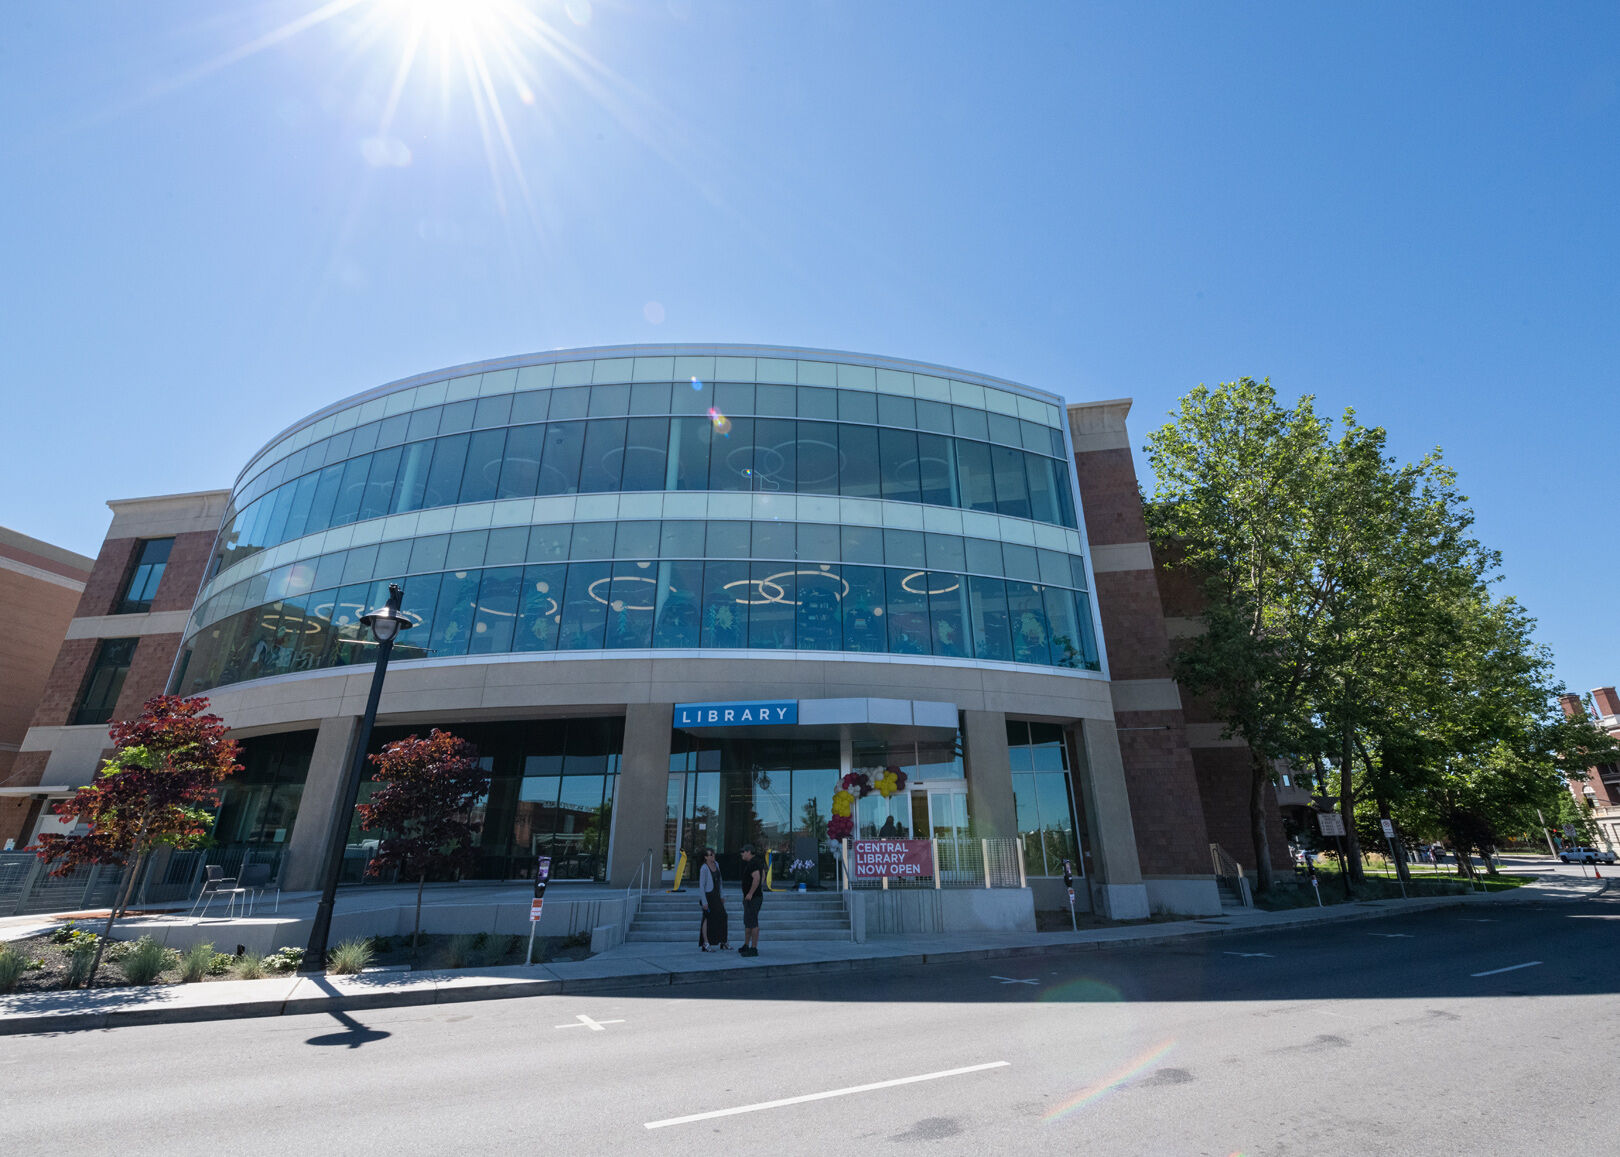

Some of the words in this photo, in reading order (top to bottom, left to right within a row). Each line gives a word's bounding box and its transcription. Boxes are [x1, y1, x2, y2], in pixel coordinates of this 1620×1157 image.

[683, 708, 787, 723] LIBRARY
[856, 843, 909, 852] CENTRAL
[857, 854, 905, 863] LIBRARY
[857, 864, 887, 874] NOW
[890, 864, 921, 874] OPEN
